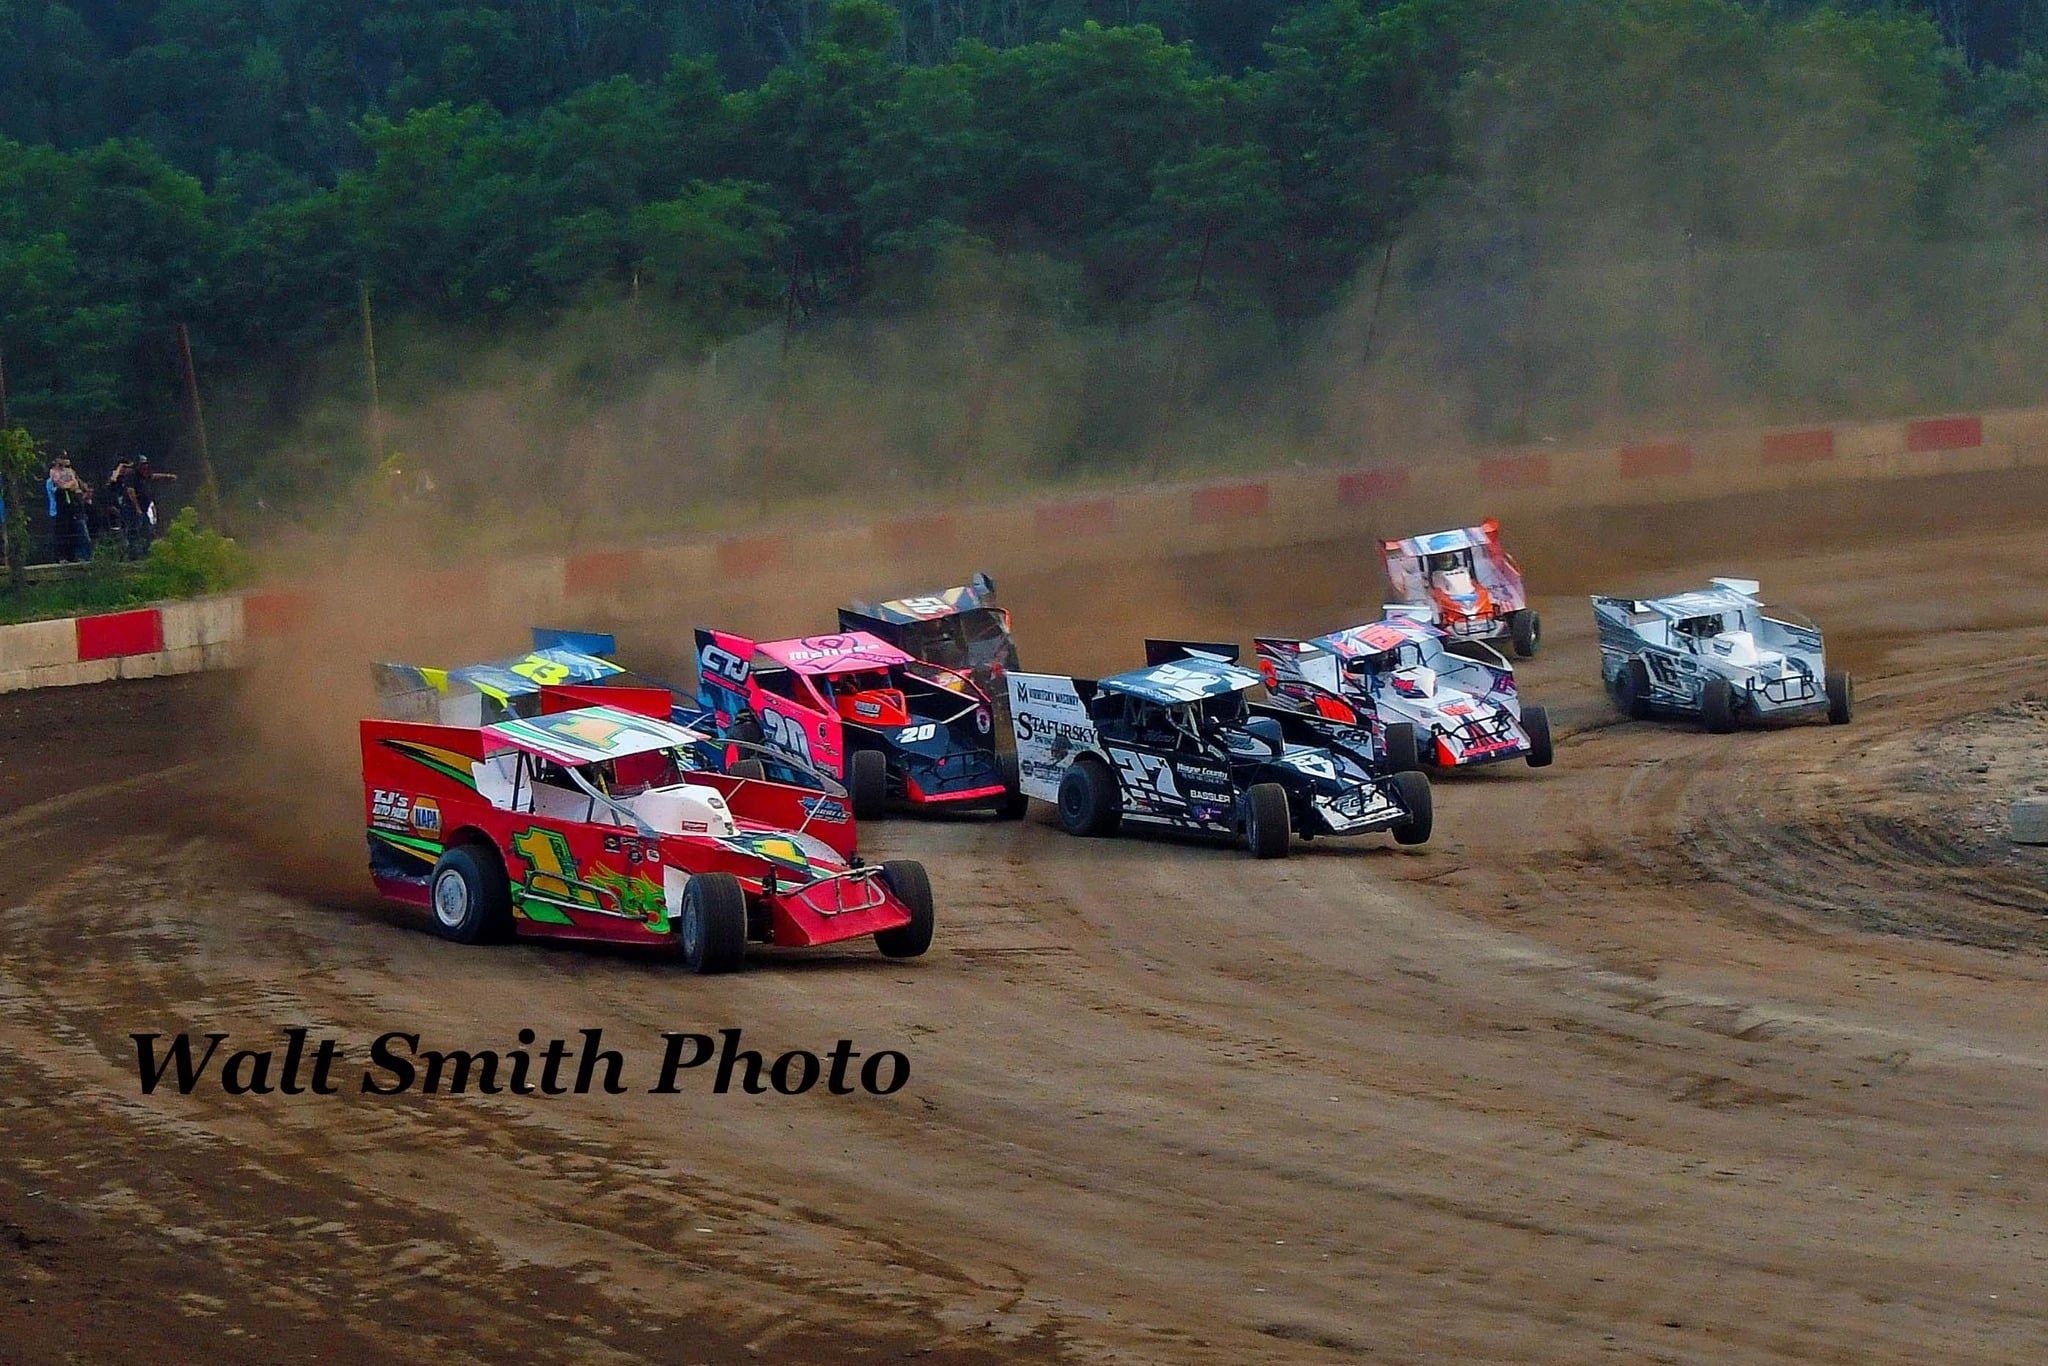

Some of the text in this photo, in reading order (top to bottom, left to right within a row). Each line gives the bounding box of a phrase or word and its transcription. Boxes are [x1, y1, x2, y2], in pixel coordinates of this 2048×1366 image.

[900, 724, 936, 743] 20
[1017, 711, 1097, 744] STAFURSKY
[1201, 765, 1230, 781] County
[1190, 789, 1231, 804] BASSLER
[415, 807, 439, 829] NAPA
[514, 826, 602, 909] 1
